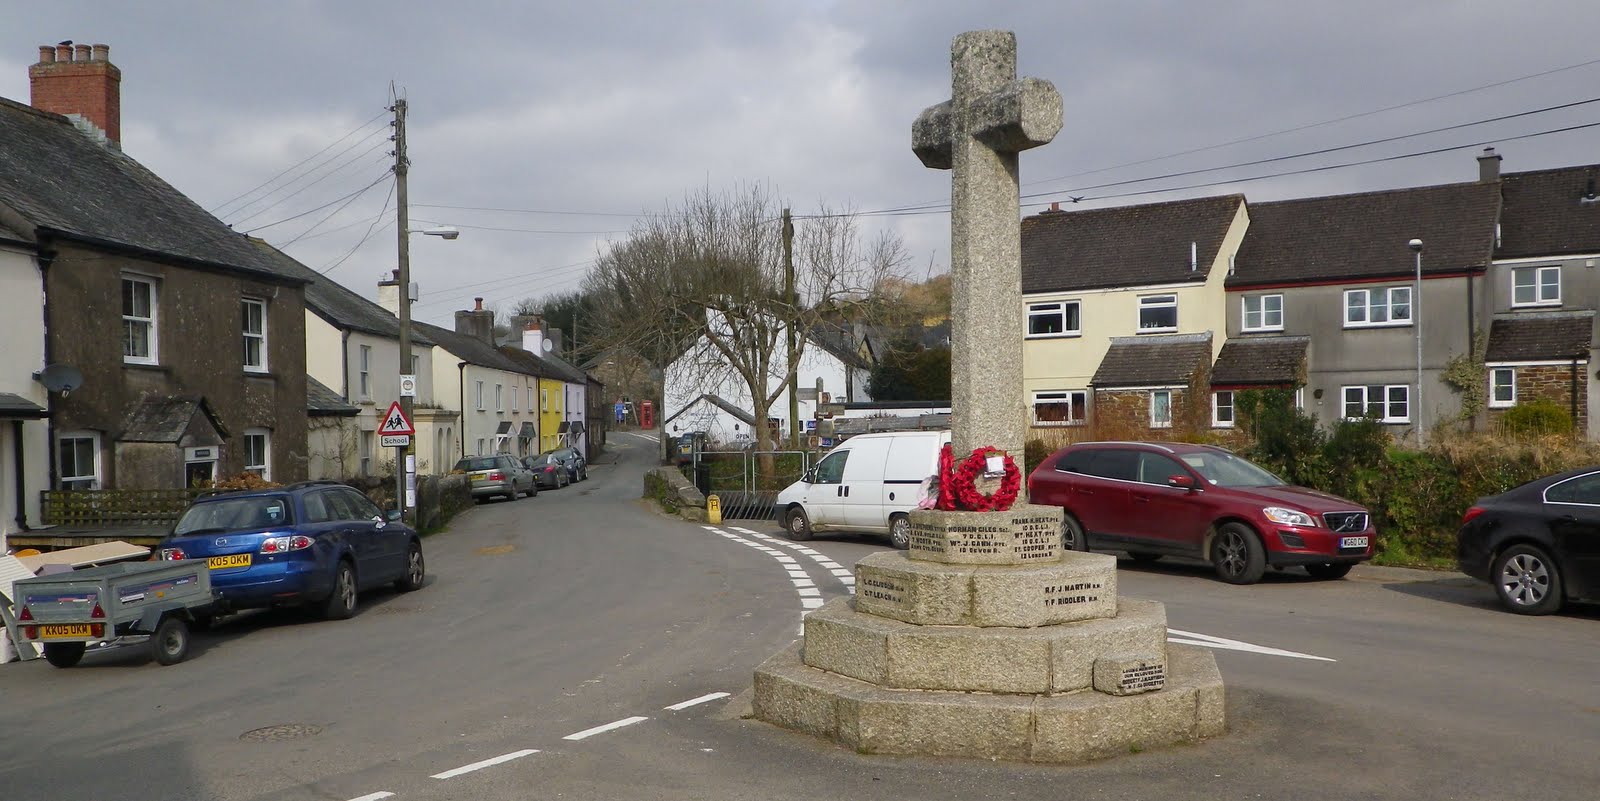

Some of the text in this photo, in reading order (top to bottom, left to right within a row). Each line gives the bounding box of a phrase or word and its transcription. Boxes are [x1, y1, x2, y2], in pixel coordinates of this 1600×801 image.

[210, 554, 248, 566] K05 OKM
[1064, 583, 1091, 591] MARTIN
[71, 625, 88, 634] OKM
